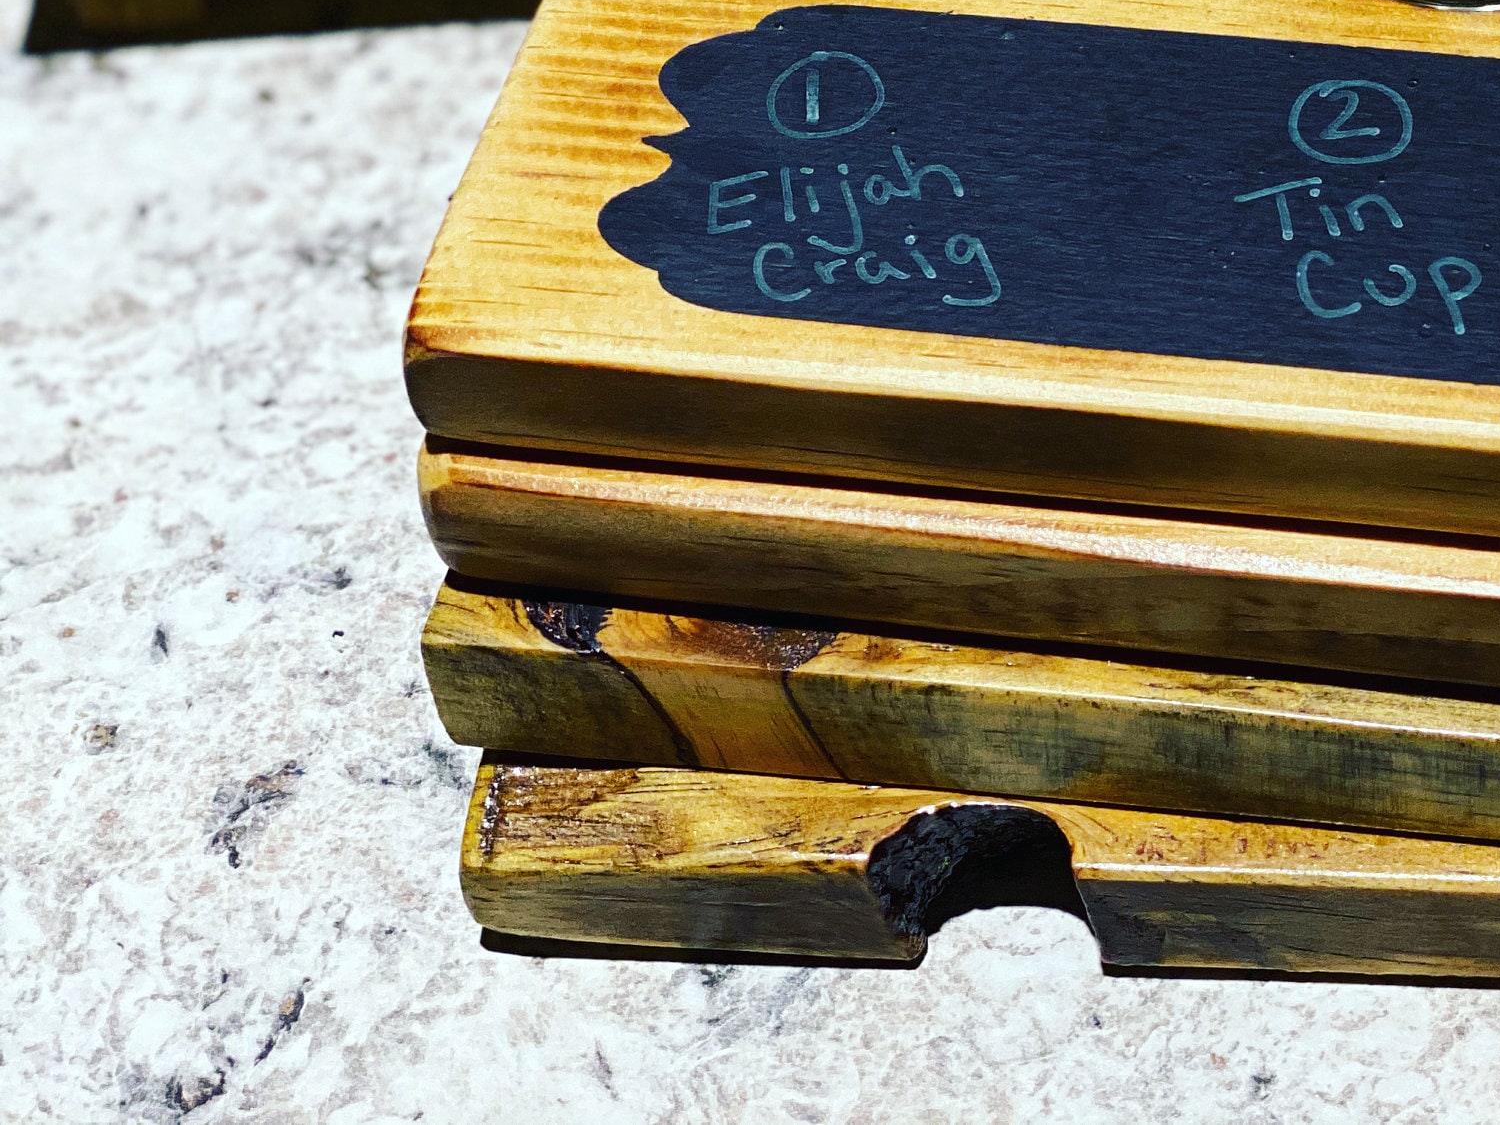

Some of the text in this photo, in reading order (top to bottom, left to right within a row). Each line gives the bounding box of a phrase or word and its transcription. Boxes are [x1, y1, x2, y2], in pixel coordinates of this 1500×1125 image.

[1318, 87, 1381, 141] 2
[707, 145, 965, 255] Elijah
[1233, 175, 1405, 242] Tin
[752, 233, 1002, 307] Craig
[1295, 249, 1484, 336] Cup
